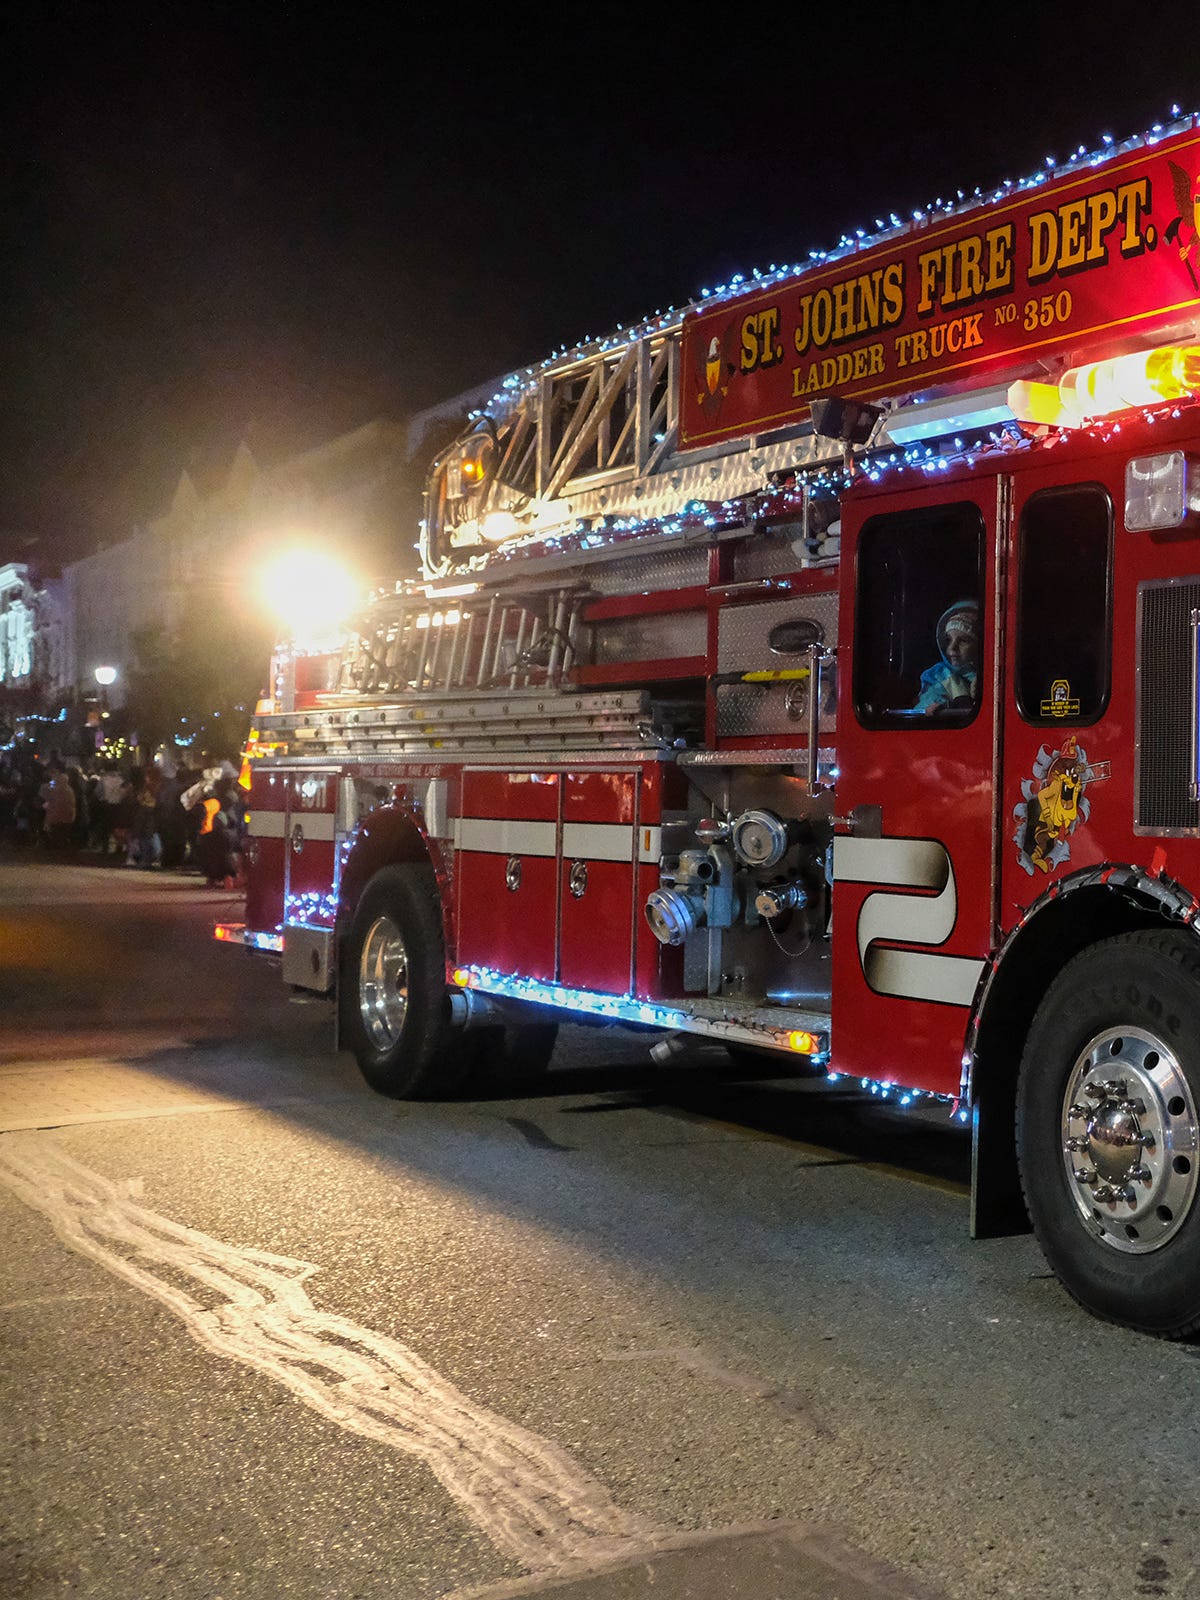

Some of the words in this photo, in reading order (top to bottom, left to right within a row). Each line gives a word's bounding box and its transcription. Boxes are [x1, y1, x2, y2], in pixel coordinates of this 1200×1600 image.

[741, 307, 783, 370] ST.
[795, 262, 903, 352] JOHNS
[918, 225, 1013, 313] FIRE
[1027, 179, 1156, 279] DEPT.
[792, 343, 886, 398] LADDER
[895, 313, 984, 367] TRUCK
[1023, 290, 1073, 332] 350
